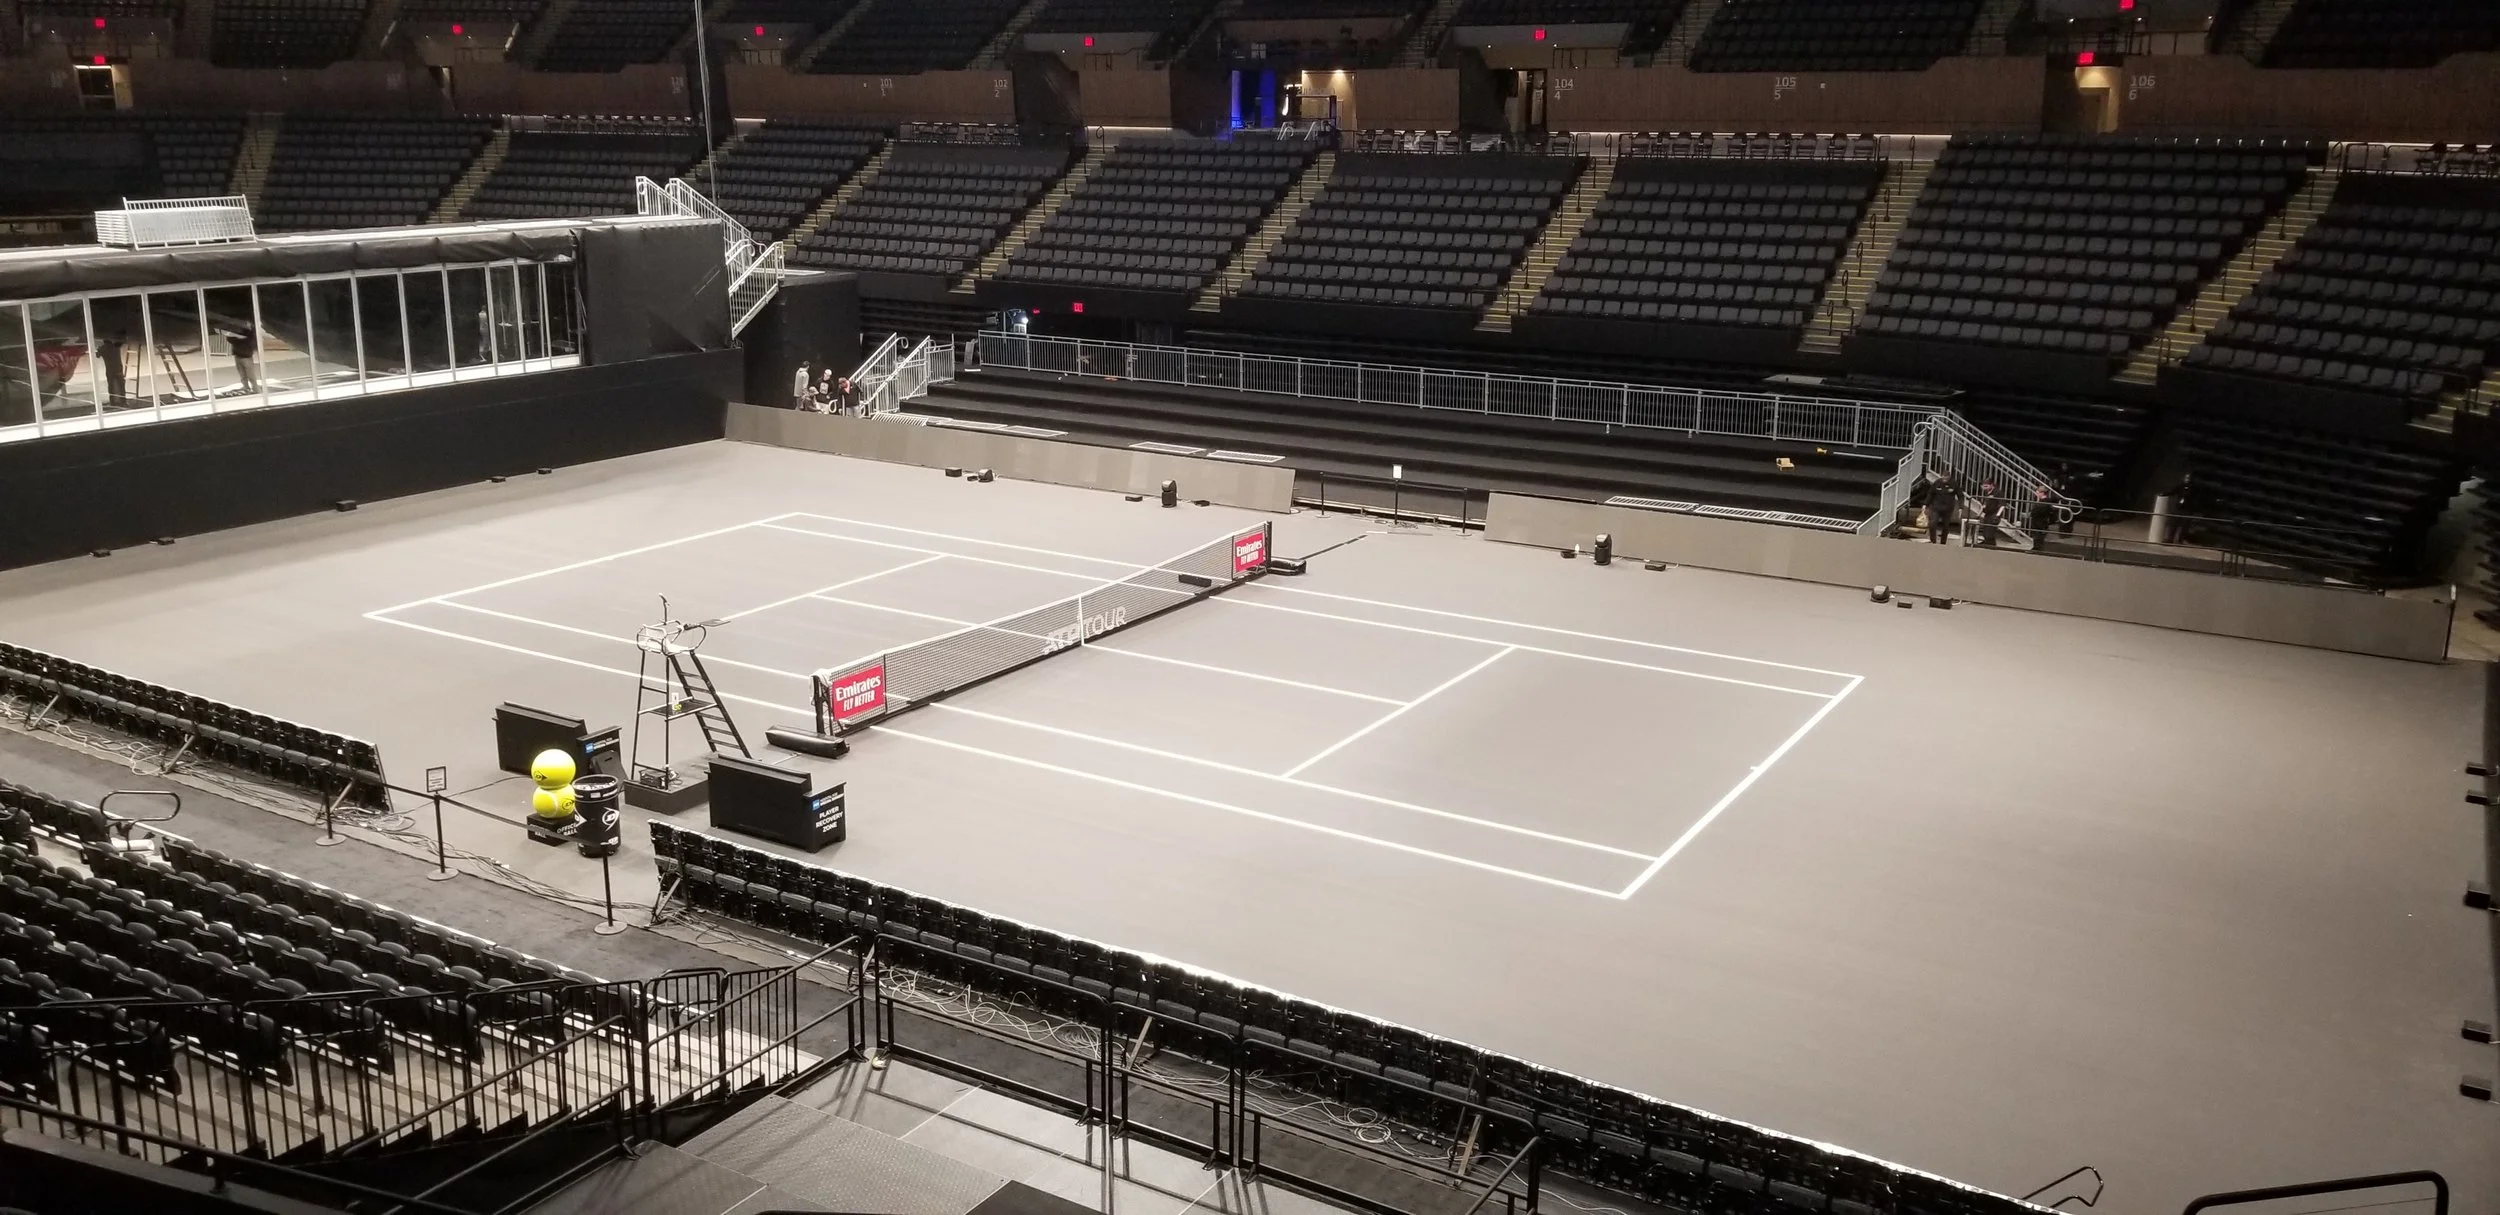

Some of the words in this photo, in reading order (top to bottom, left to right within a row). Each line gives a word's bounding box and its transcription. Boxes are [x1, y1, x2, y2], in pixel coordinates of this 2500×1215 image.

[880, 78, 893, 88] 101
[994, 79, 1008, 88] 102
[1555, 78, 1574, 89] 104
[1776, 77, 1796, 87] 105
[2130, 75, 2156, 87] 106
[1554, 91, 1561, 101] 4
[1774, 89, 1782, 100] 5
[2129, 89, 2137, 101] 6
[1236, 540, 1263, 558] Emirates
[1083, 606, 1127, 639] TOUR
[835, 675, 882, 702] Emirates
[843, 697, 854, 712] FLY
[819, 805, 840, 819] PLAYER
[815, 811, 844, 828] RECOVERY
[822, 821, 838, 833] ZONE
